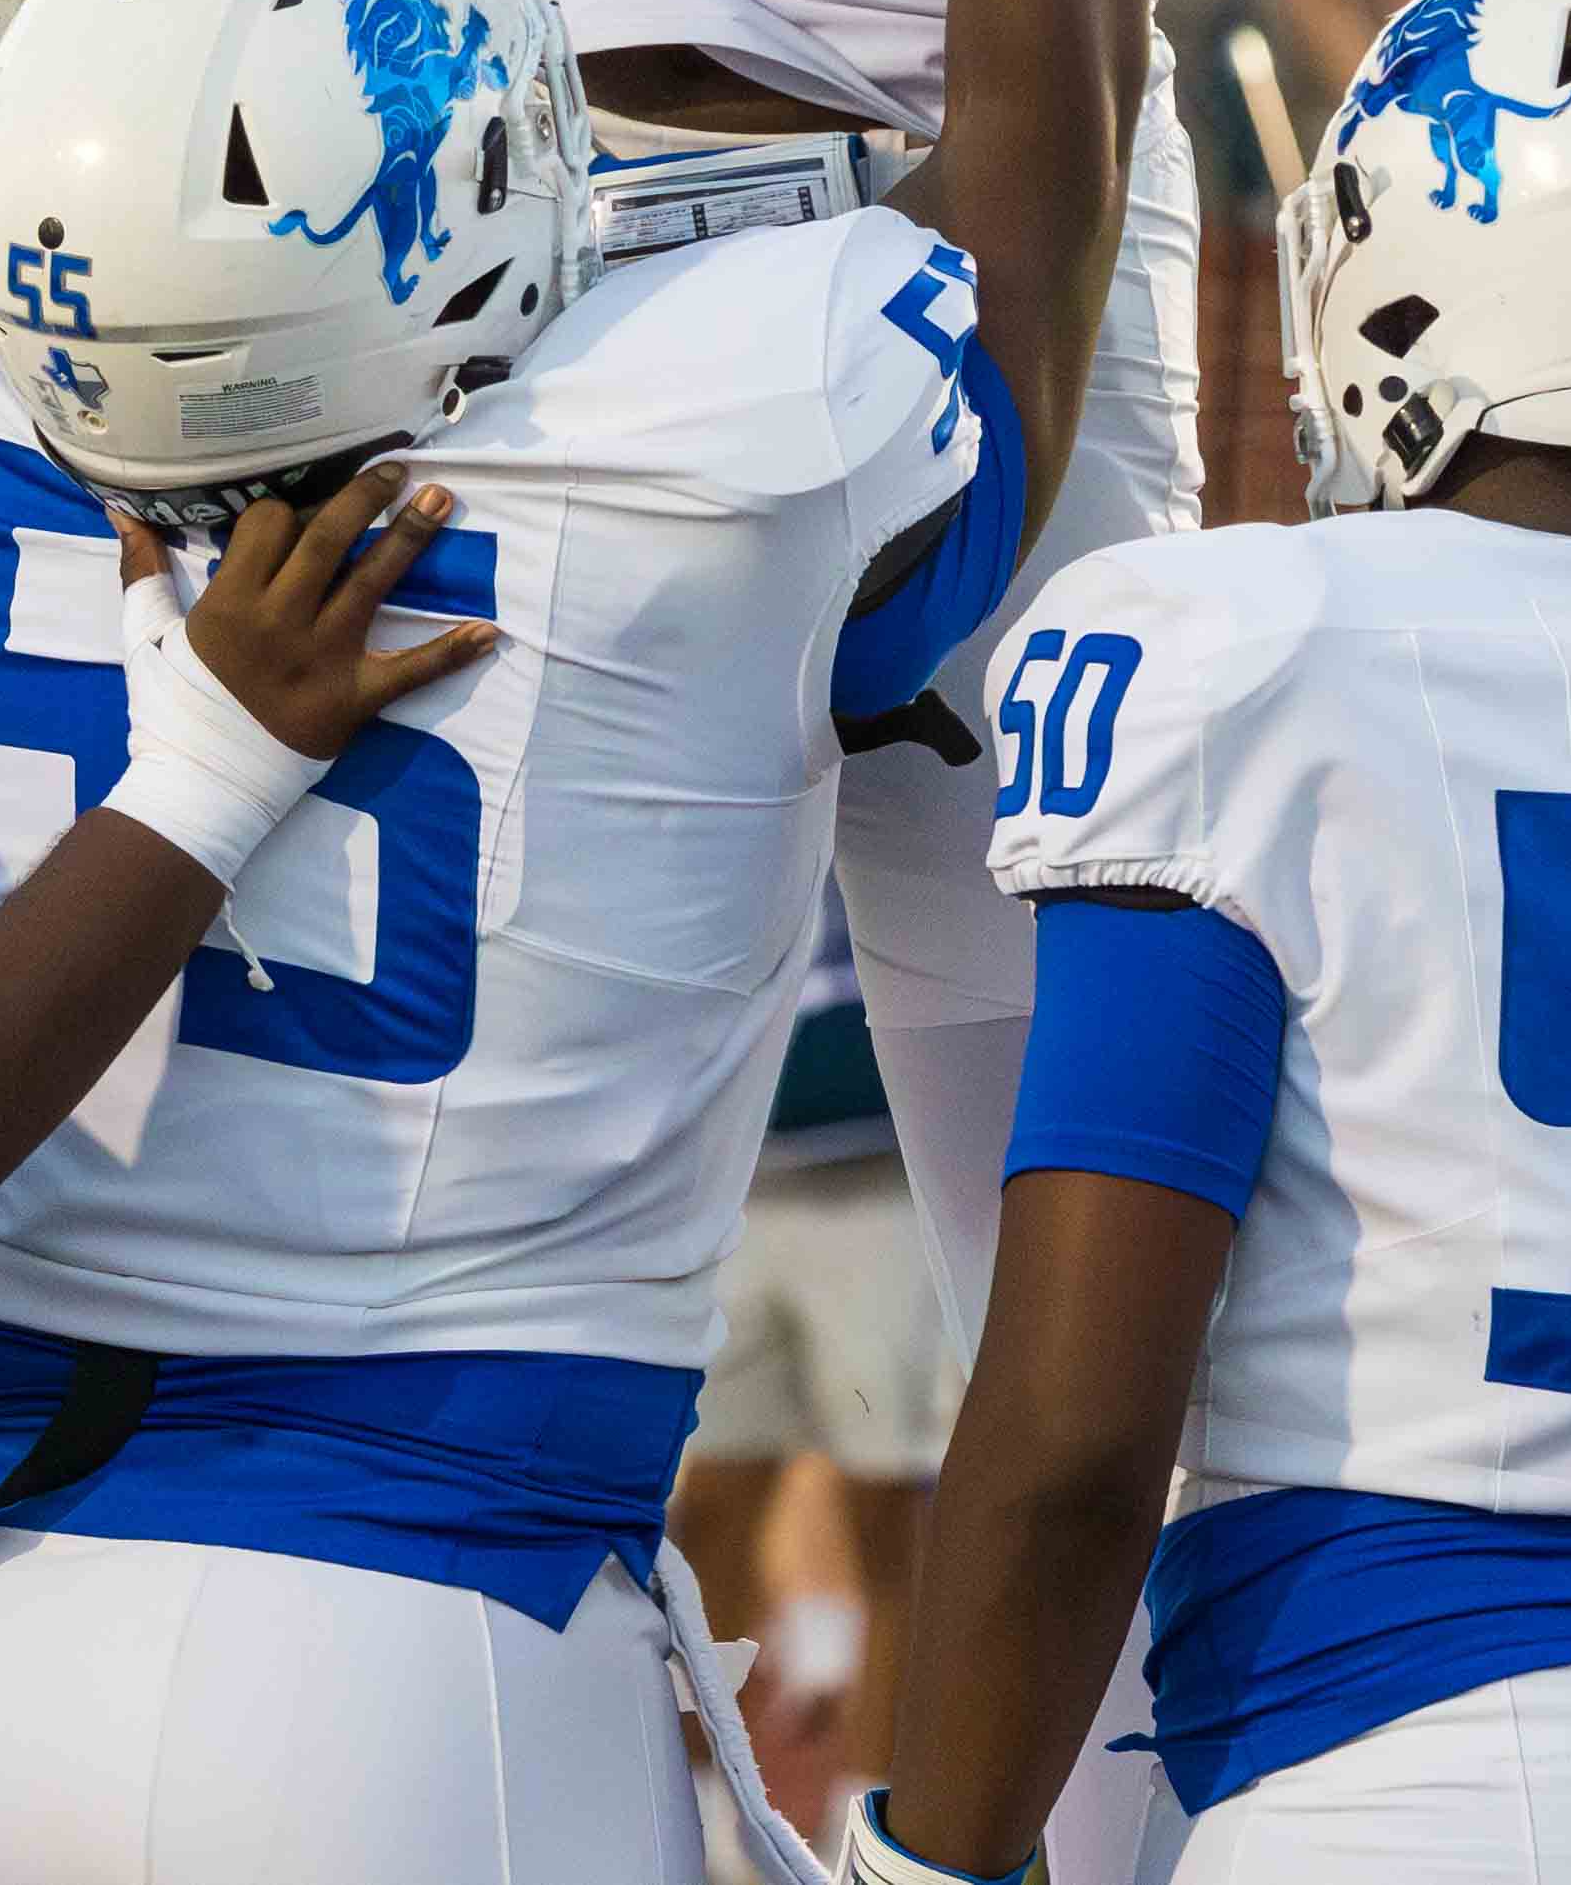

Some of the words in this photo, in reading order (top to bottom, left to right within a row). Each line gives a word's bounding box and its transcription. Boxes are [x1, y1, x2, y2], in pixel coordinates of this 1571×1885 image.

[7, 241, 98, 340] 55
[222, 376, 278, 394] WARNING
[995, 630, 1143, 818] 50
